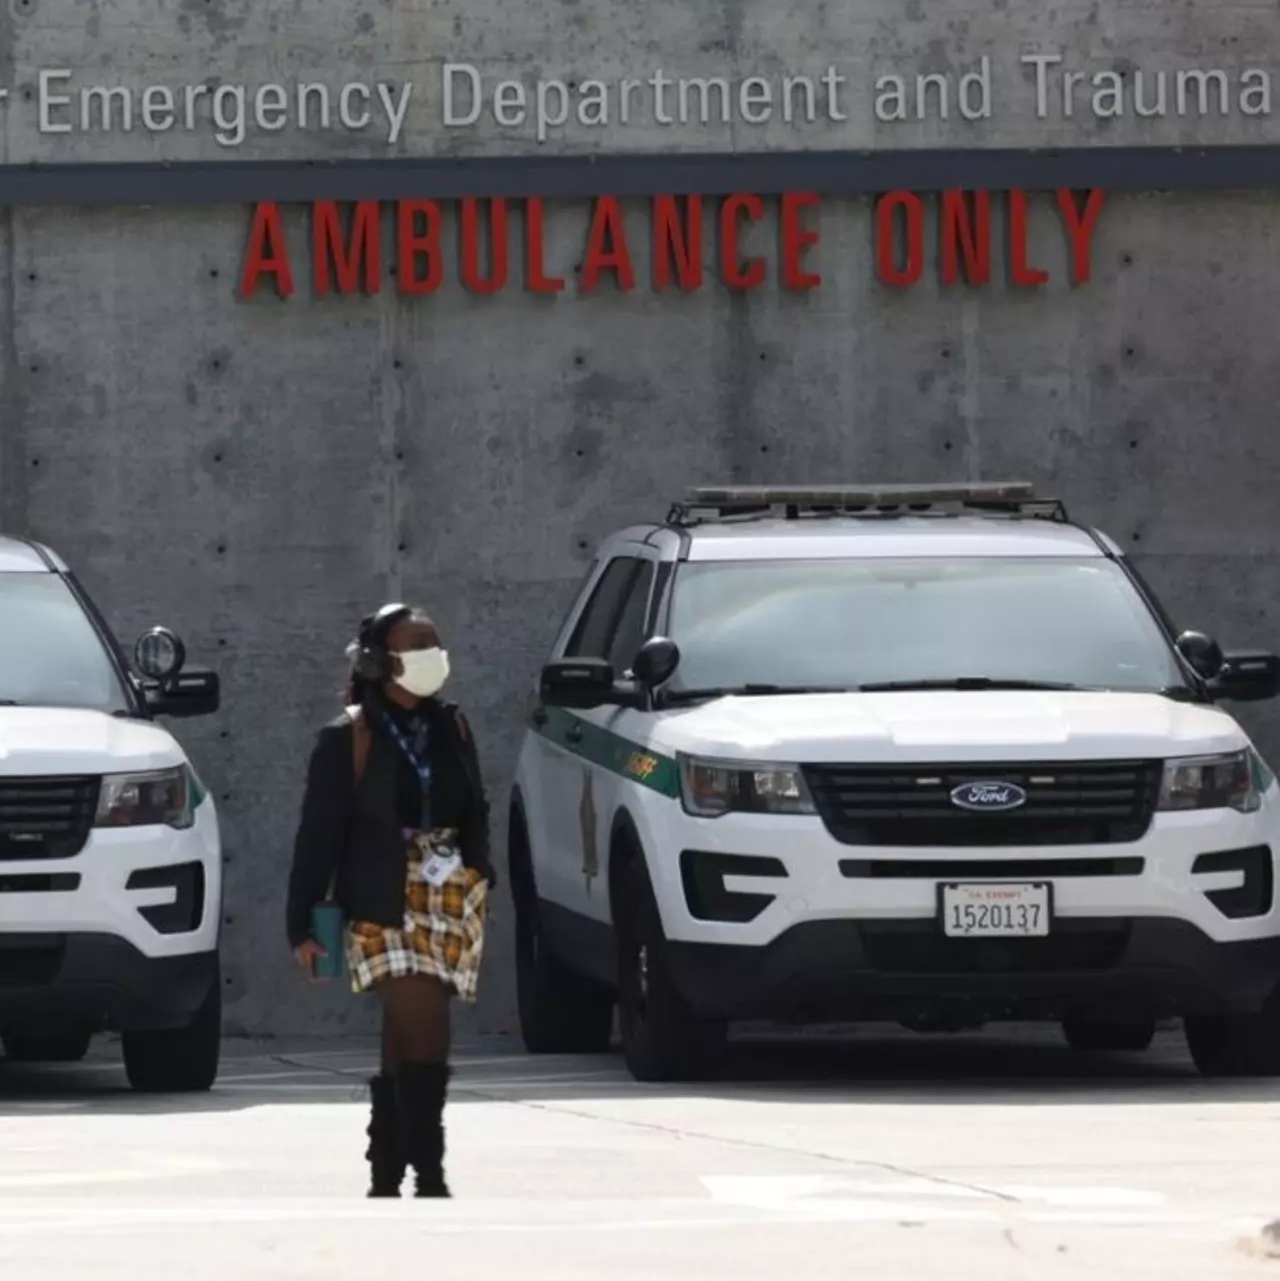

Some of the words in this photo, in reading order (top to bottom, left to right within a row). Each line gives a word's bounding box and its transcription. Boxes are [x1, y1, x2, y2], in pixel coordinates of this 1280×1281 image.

[39, 68, 412, 145] Emergency
[443, 63, 845, 142] Department
[875, 55, 992, 119] and
[1021, 54, 1271, 117] Trauma
[241, 194, 822, 296] AMBULANCE
[875, 188, 1106, 288] ONLY
[968, 785, 1008, 802] Ford
[951, 903, 1041, 930] 1520137
